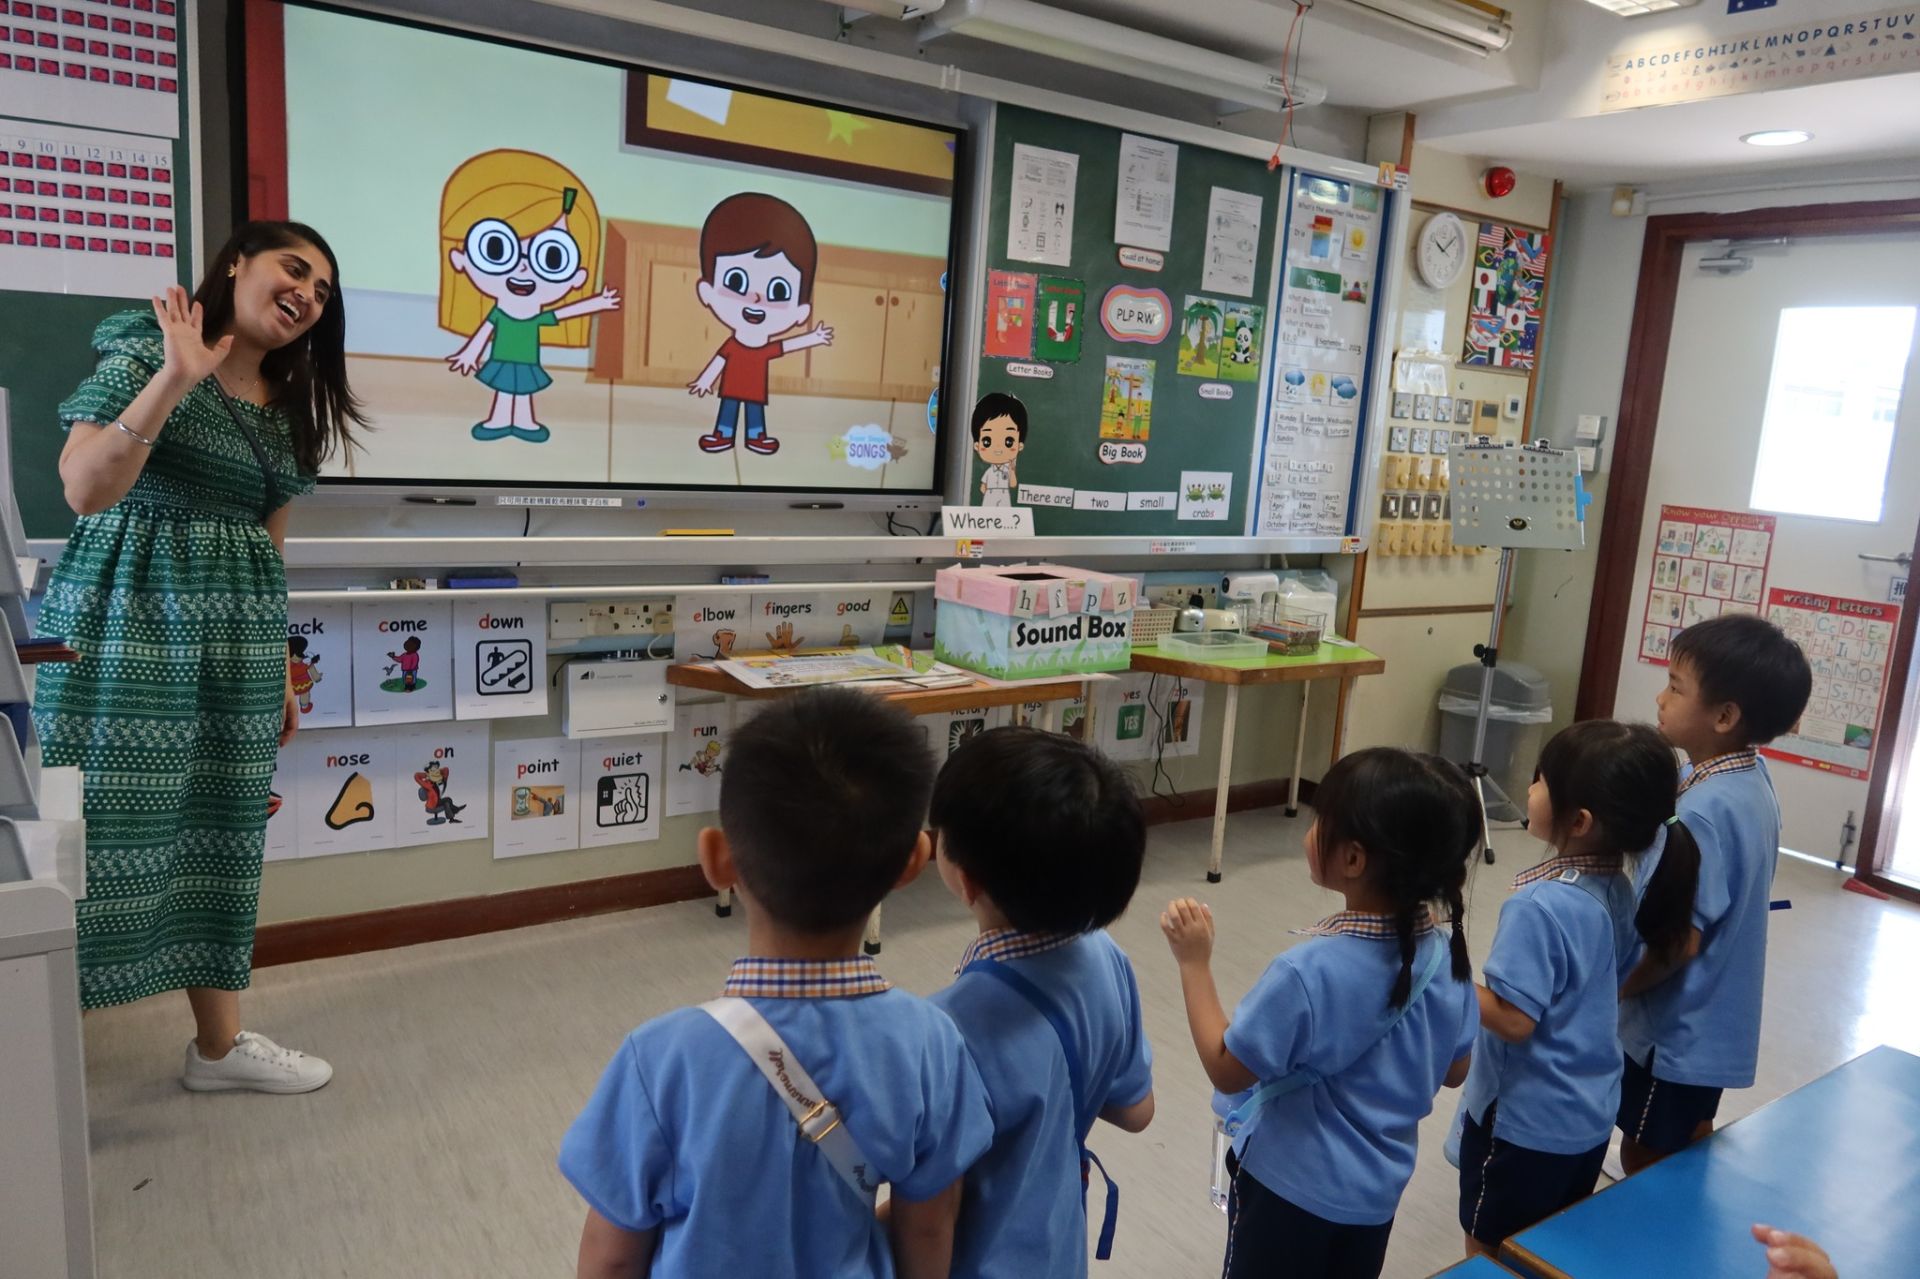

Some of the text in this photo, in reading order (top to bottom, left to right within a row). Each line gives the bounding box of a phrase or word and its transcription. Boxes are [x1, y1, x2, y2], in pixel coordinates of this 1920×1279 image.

[18, 139, 167, 165] 9 10 11 12 13 14 15
[1117, 308, 1155, 324] PLP RW
[1009, 364, 1053, 377] Letter Books
[849, 443, 886, 458] SONGS
[1102, 445, 1143, 460] Big Book
[1019, 489, 1215, 518] There are two small crabs
[836, 599, 872, 616] good
[1019, 590, 1031, 610] h
[1086, 594, 1097, 612] p
[1117, 592, 1127, 606] z
[1836, 599, 1883, 617] letters
[693, 607, 735, 622] elbow
[764, 601, 812, 618] fingers
[288, 617, 324, 635] ack
[378, 619, 428, 633] come
[478, 613, 524, 629] down
[1016, 615, 1126, 647] Sound Box
[1123, 691, 1141, 703] yes
[693, 726, 717, 737] run
[1124, 716, 1139, 731] YES
[326, 753, 370, 768] nose
[434, 747, 454, 758] on
[517, 758, 559, 779] point
[602, 751, 643, 771] quiet
